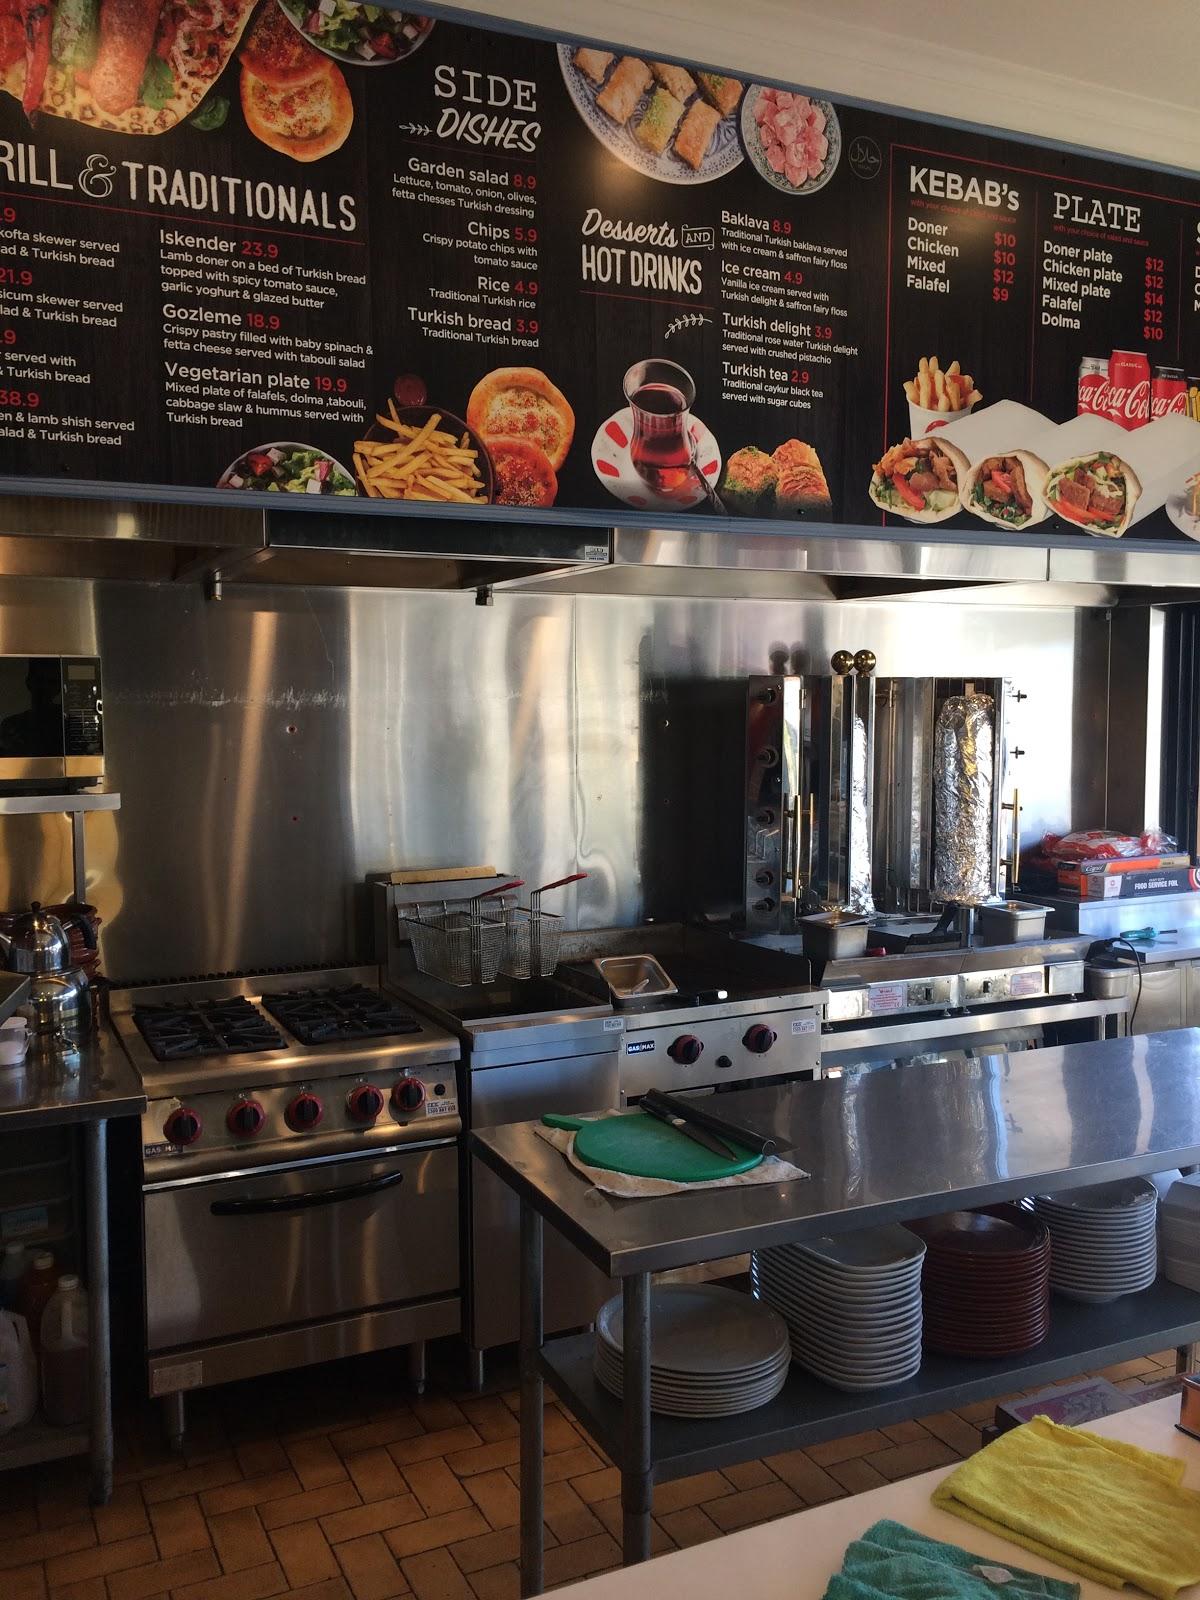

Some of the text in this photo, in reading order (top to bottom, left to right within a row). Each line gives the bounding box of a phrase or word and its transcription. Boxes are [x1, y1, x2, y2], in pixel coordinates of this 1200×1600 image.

[434, 64, 537, 112] SIDE
[436, 107, 542, 152] DISHES
[409, 158, 537, 189] Garden salad 8.9
[909, 165, 1020, 211] KEBAB's
[78, 153, 117, 199] &
[121, 160, 357, 232] TRADITIONALS
[392, 188, 534, 218] fetta chesses Turkish dressing
[394, 173, 536, 204] Lettuce, tomato, onion, olives,
[722, 211, 792, 234] Baklava 8.9
[1053, 192, 1141, 233] PLATE
[33, 233, 76, 246] skewer
[80, 240, 119, 252] served
[468, 222, 538, 242] Chips 5.9
[581, 208, 711, 248] Desserts AND
[721, 227, 847, 257] Traditional Turkish baklava served
[908, 217, 1016, 247] Doner $10
[161, 230, 280, 258] Iskender 23.9
[423, 233, 537, 256] Crispy potato chips with
[907, 236, 1016, 266] Chicken $10
[1043, 240, 1164, 272] Doner plate $12
[161, 249, 192, 262] Lamb
[196, 254, 229, 266] doner
[232, 260, 245, 269] on
[258, 261, 279, 273] bed
[282, 266, 293, 275] of
[296, 267, 333, 280] Turkish
[336, 272, 366, 284] bread
[474, 255, 537, 270] tomato sauce
[581, 244, 702, 295] HOT DRINKS
[722, 260, 804, 285] Ice cream 4.9
[907, 255, 1014, 284] Mixed $12
[1043, 259, 1164, 289] Chicken plate $12
[161, 265, 337, 297] topped with spicy tomato sauce,
[162, 282, 324, 308] garlic yoghurt & glazed butter
[478, 276, 539, 295] Rice 4.9
[906, 274, 1009, 302] Falafel $9
[1042, 276, 1163, 306] Mixed plate $14
[37, 294, 80, 307] skewer
[83, 301, 123, 312] served
[163, 304, 281, 330] Gozleme 18.9
[1042, 294, 1163, 324] Falafel $12
[408, 307, 539, 333] Turkish bread 3.9
[723, 313, 833, 339] Turkish delight 3.9
[1041, 312, 1164, 341] Dolma $10
[163, 324, 373, 354] Crispy pastry filled with baby spinach &
[164, 338, 365, 368] fetta cheese served with tabouli salad
[165, 362, 348, 393] Vegetarian plate 19.9
[723, 362, 810, 384] Turkish tea 2.9
[166, 382, 199, 393] Mixed
[203, 385, 230, 396] plate
[233, 388, 245, 397] of
[291, 393, 323, 405] dolma
[722, 378, 762, 390] Traditional
[791, 386, 810, 396] black
[812, 390, 823, 398] tea
[16, 412, 24, 422] &
[28, 413, 58, 424] lamb
[62, 416, 91, 427] shish
[95, 421, 134, 430] served
[166, 398, 363, 422] cabbage slaw & hummus served with
[167, 412, 242, 427] Turkish bread
[1134, 882, 1148, 890] FOOD
[1148, 880, 1167, 889] SERVICE
[1168, 879, 1179, 887] FOIL
